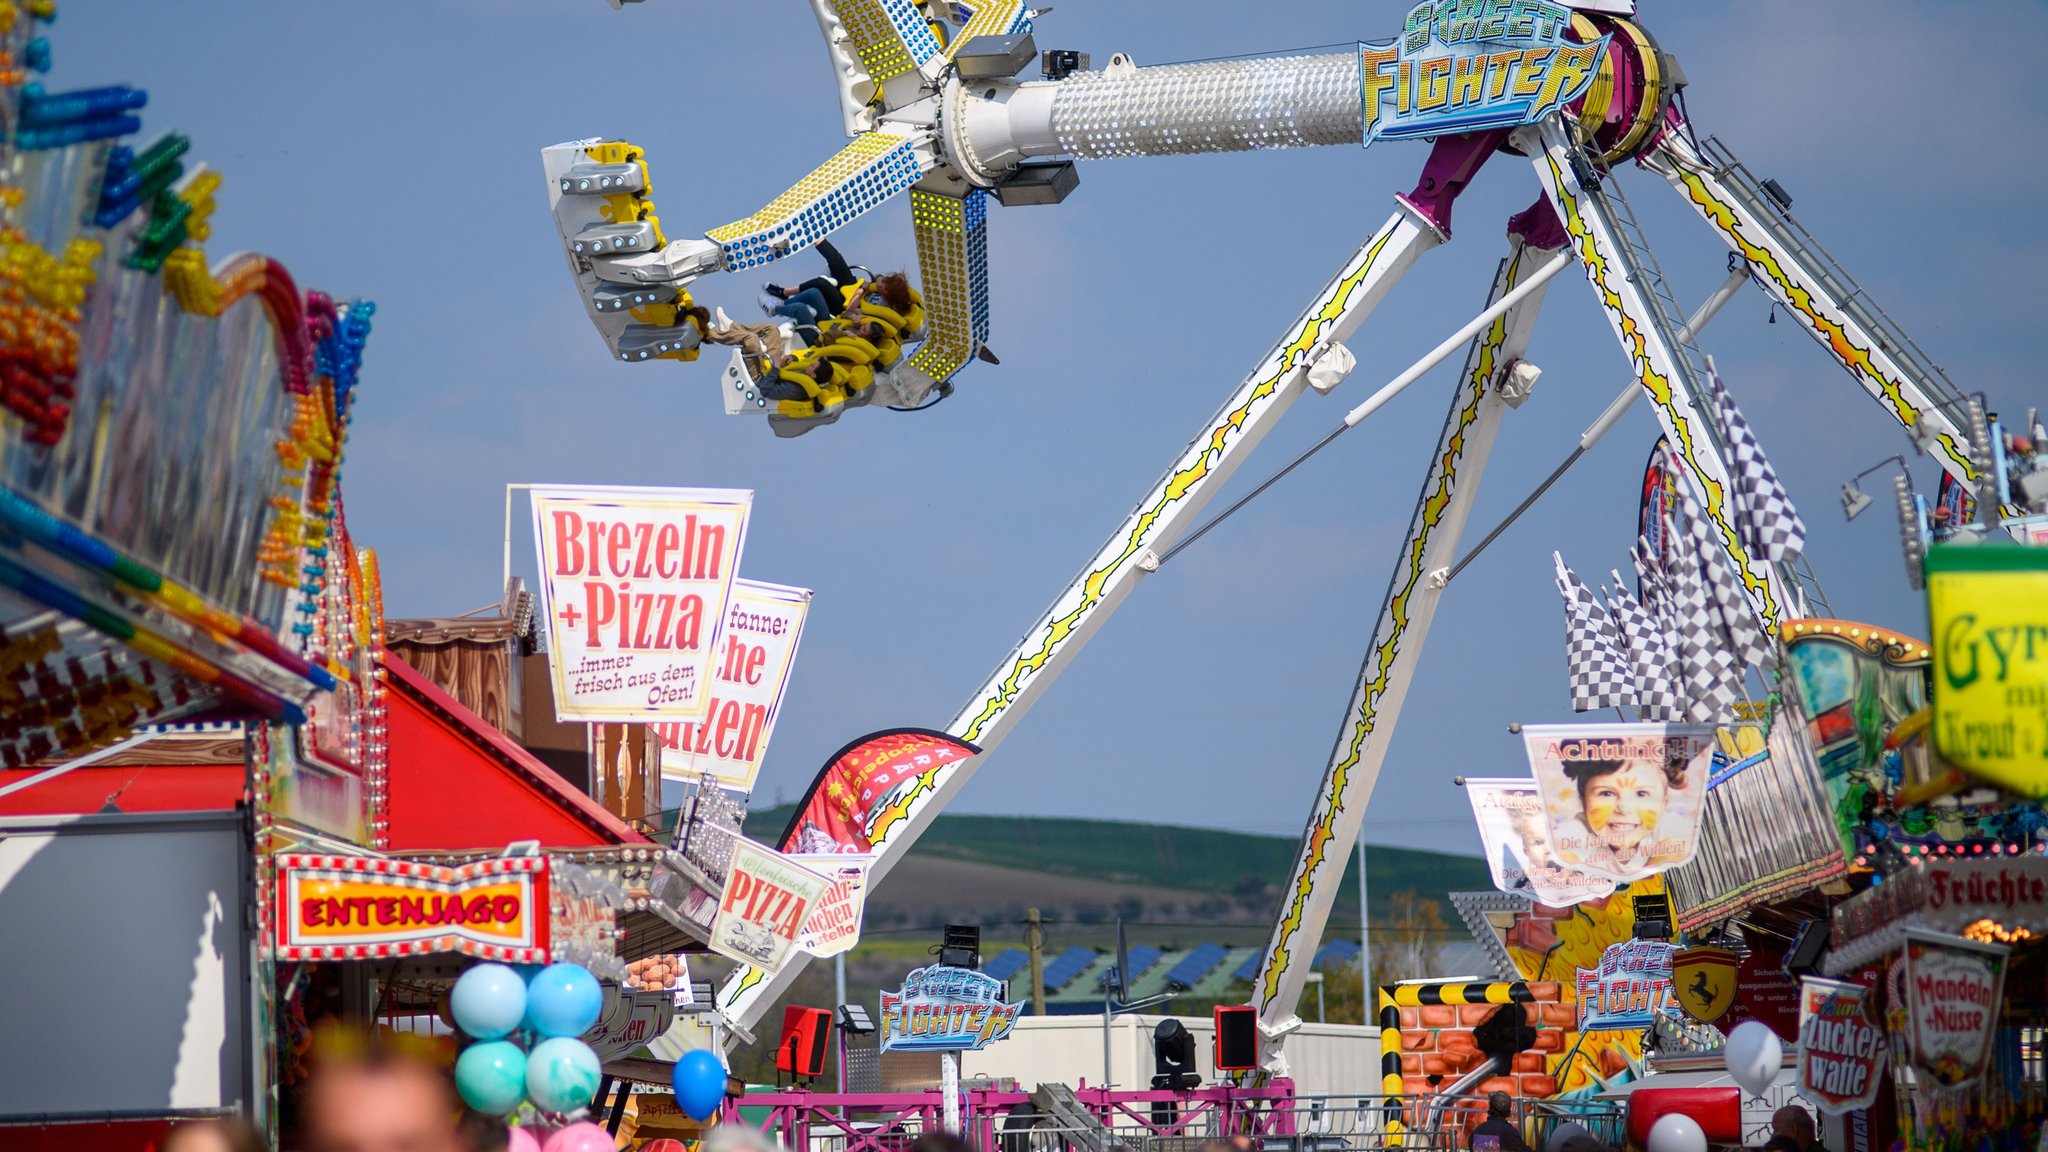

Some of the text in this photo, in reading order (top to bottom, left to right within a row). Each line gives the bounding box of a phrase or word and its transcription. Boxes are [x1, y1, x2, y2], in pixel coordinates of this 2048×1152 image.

[1404, 0, 1568, 52] STREET
[1361, 42, 1602, 132] FIGHTER
[552, 510, 725, 580] Brezeln
[558, 581, 704, 650] +Pizza
[729, 603, 788, 635] fanne:
[1943, 611, 2048, 690] Gyr
[574, 664, 695, 695] frisch aus dem
[647, 681, 696, 705] Ofen!
[1561, 836, 1582, 850] Die
[1502, 867, 1519, 880] Die
[1929, 867, 2047, 909] Früchte
[301, 894, 520, 928] ENTENJAGD
[722, 868, 807, 941] PIZZA
[807, 902, 853, 934] uchen
[905, 967, 997, 1000] STREET
[1916, 973, 1991, 1008] Mandeln
[880, 995, 1018, 1046] FIGHTER
[1811, 1055, 1868, 1096] watte
